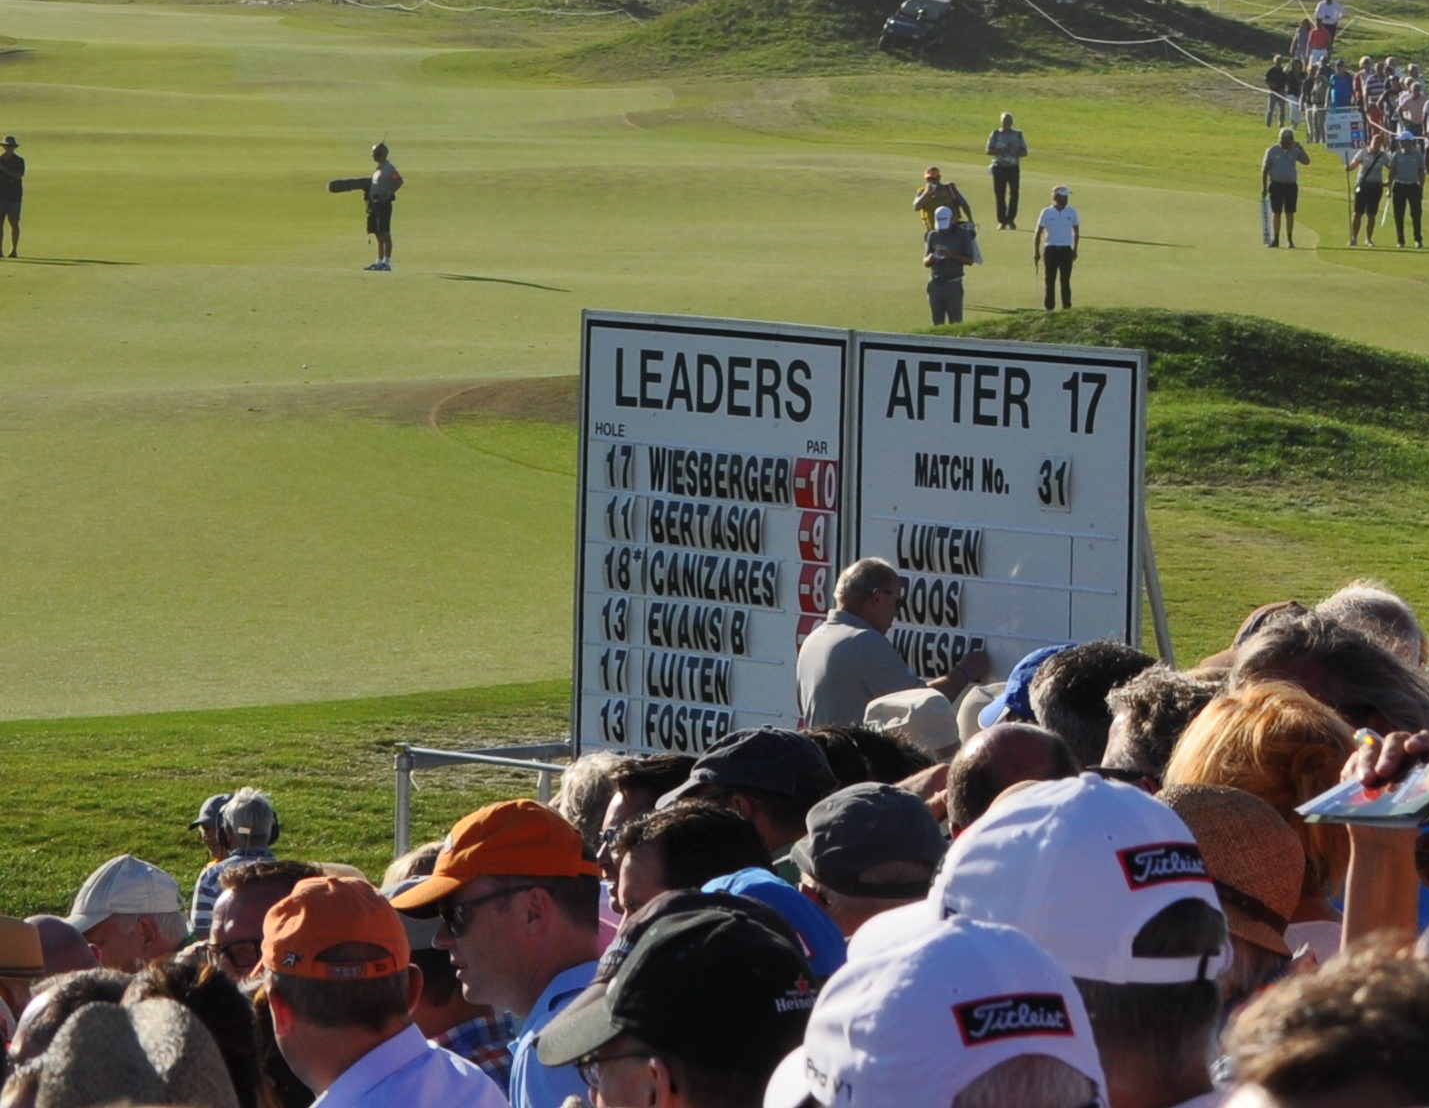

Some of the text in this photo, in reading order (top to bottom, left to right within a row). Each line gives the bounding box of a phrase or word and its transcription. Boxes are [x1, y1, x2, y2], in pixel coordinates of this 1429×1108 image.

[614, 347, 813, 423] LEADERS
[886, 359, 1109, 434] AFTER 17
[595, 422, 625, 438] HOLE
[806, 440, 828, 455] PAR
[606, 444, 632, 489] 17
[649, 446, 791, 504] WIESBERGER
[914, 452, 1068, 507] MATCH No. 31
[607, 496, 632, 540] 11
[650, 499, 761, 554] BERTASIO
[897, 523, 980, 576] LUITEN
[650, 550, 776, 608] CANIZARES
[898, 576, 959, 627] ROOS
[602, 596, 627, 642] 13
[648, 602, 722, 653] EVANS
[731, 610, 746, 655] B
[601, 648, 730, 706] 17 LUITEN
[601, 698, 626, 743] 13
[969, 1000, 1065, 1037] Titleist
